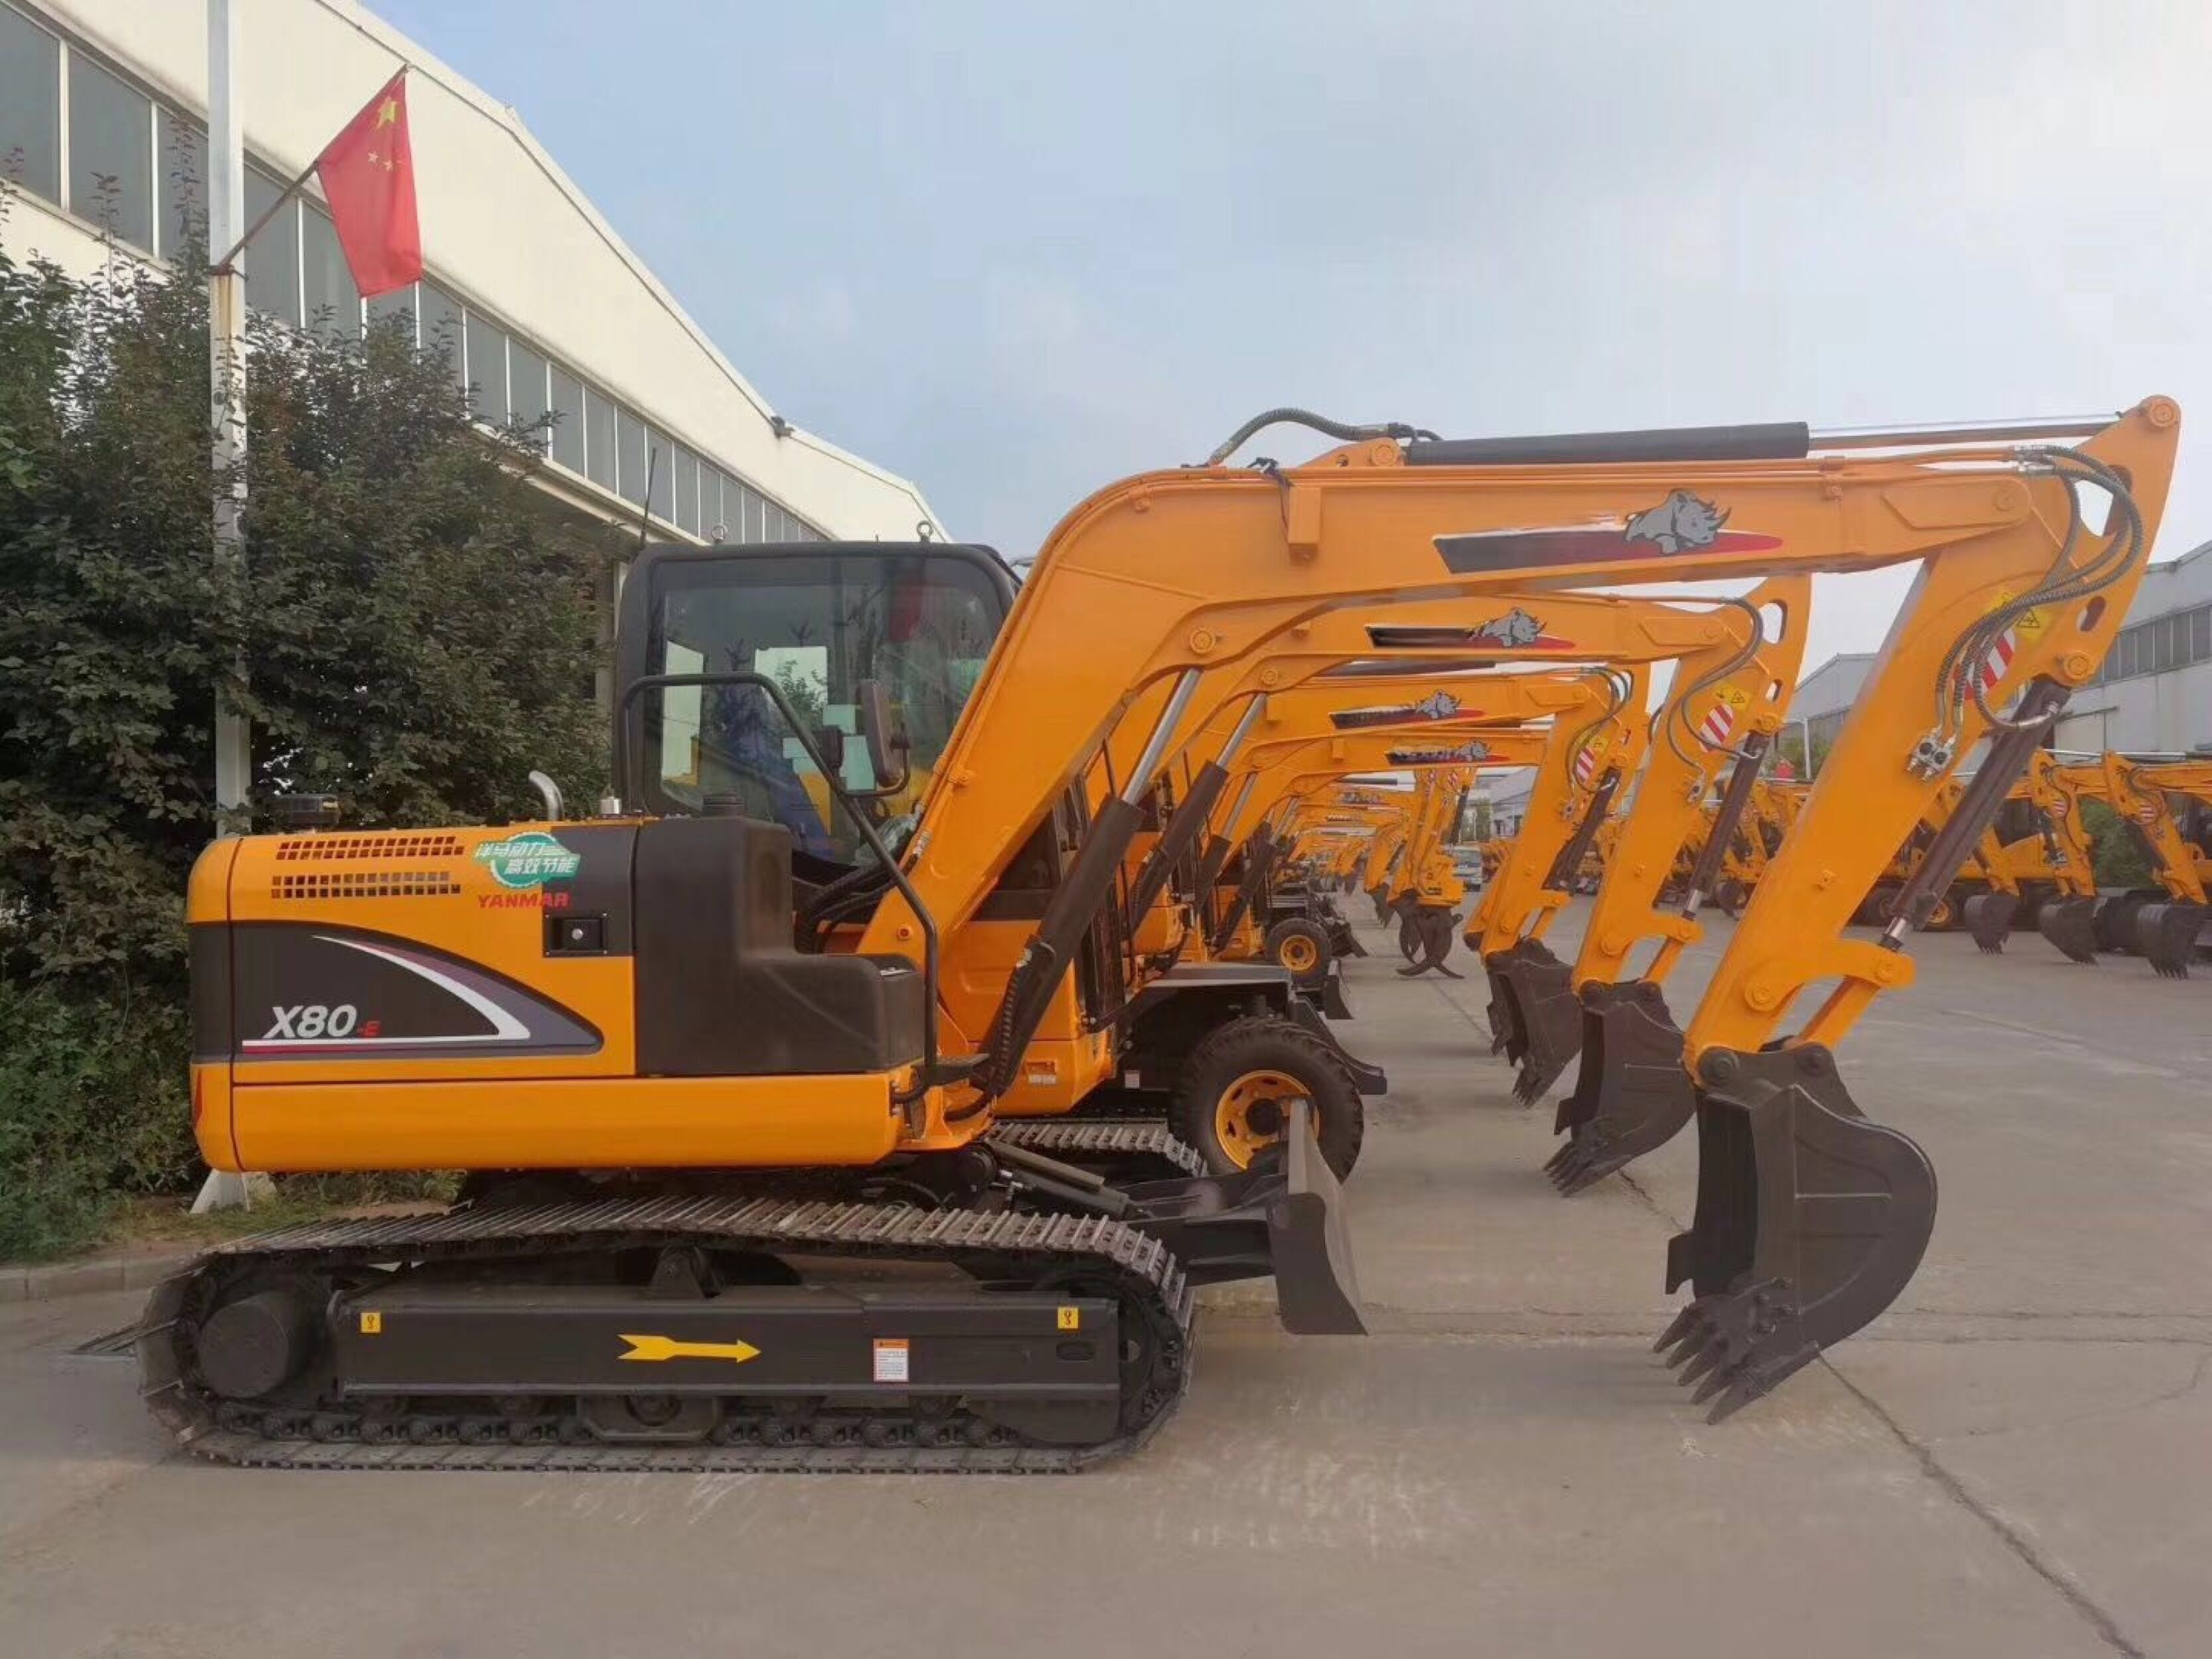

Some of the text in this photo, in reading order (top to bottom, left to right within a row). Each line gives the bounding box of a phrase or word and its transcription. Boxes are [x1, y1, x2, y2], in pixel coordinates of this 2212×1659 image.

[504, 857, 576, 875] 高效节能
[479, 893, 570, 908] YANMAR
